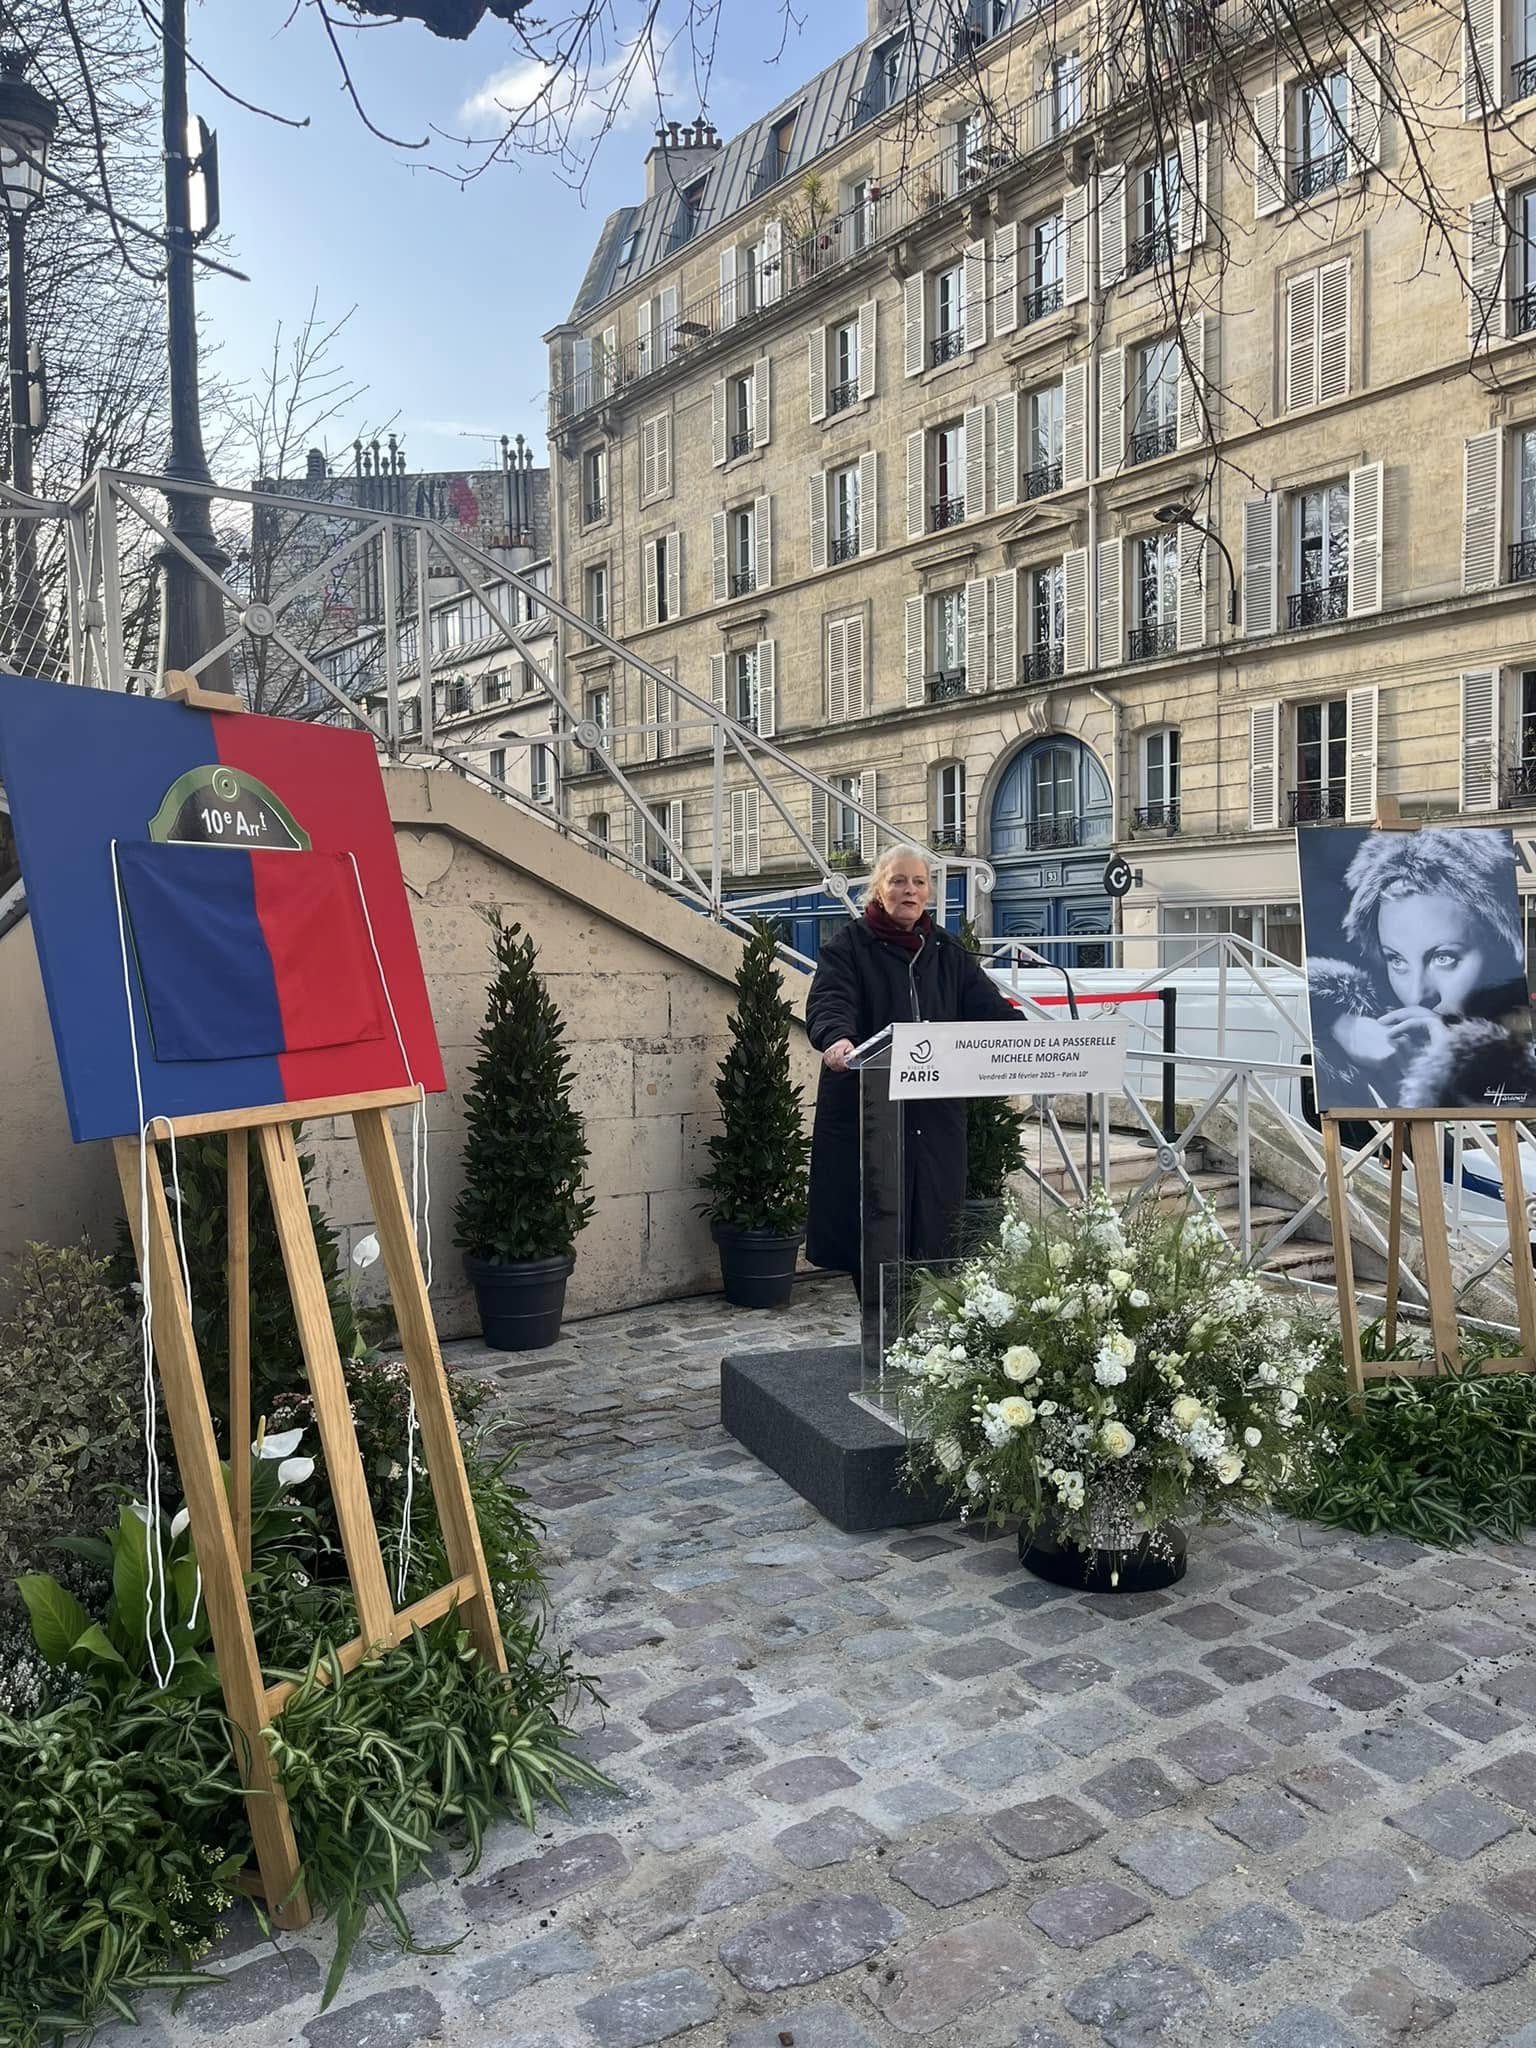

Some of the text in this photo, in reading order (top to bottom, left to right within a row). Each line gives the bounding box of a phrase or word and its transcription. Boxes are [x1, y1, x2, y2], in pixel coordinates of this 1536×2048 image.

[1512, 840, 1536, 873] A
[954, 1036, 1117, 1049] INAUGURATION DE LA PASSERELLE
[991, 1052, 1080, 1063] MICHELE MORGAN
[900, 1070, 940, 1082] PARIS
[978, 1072, 1007, 1080] Vendredi
